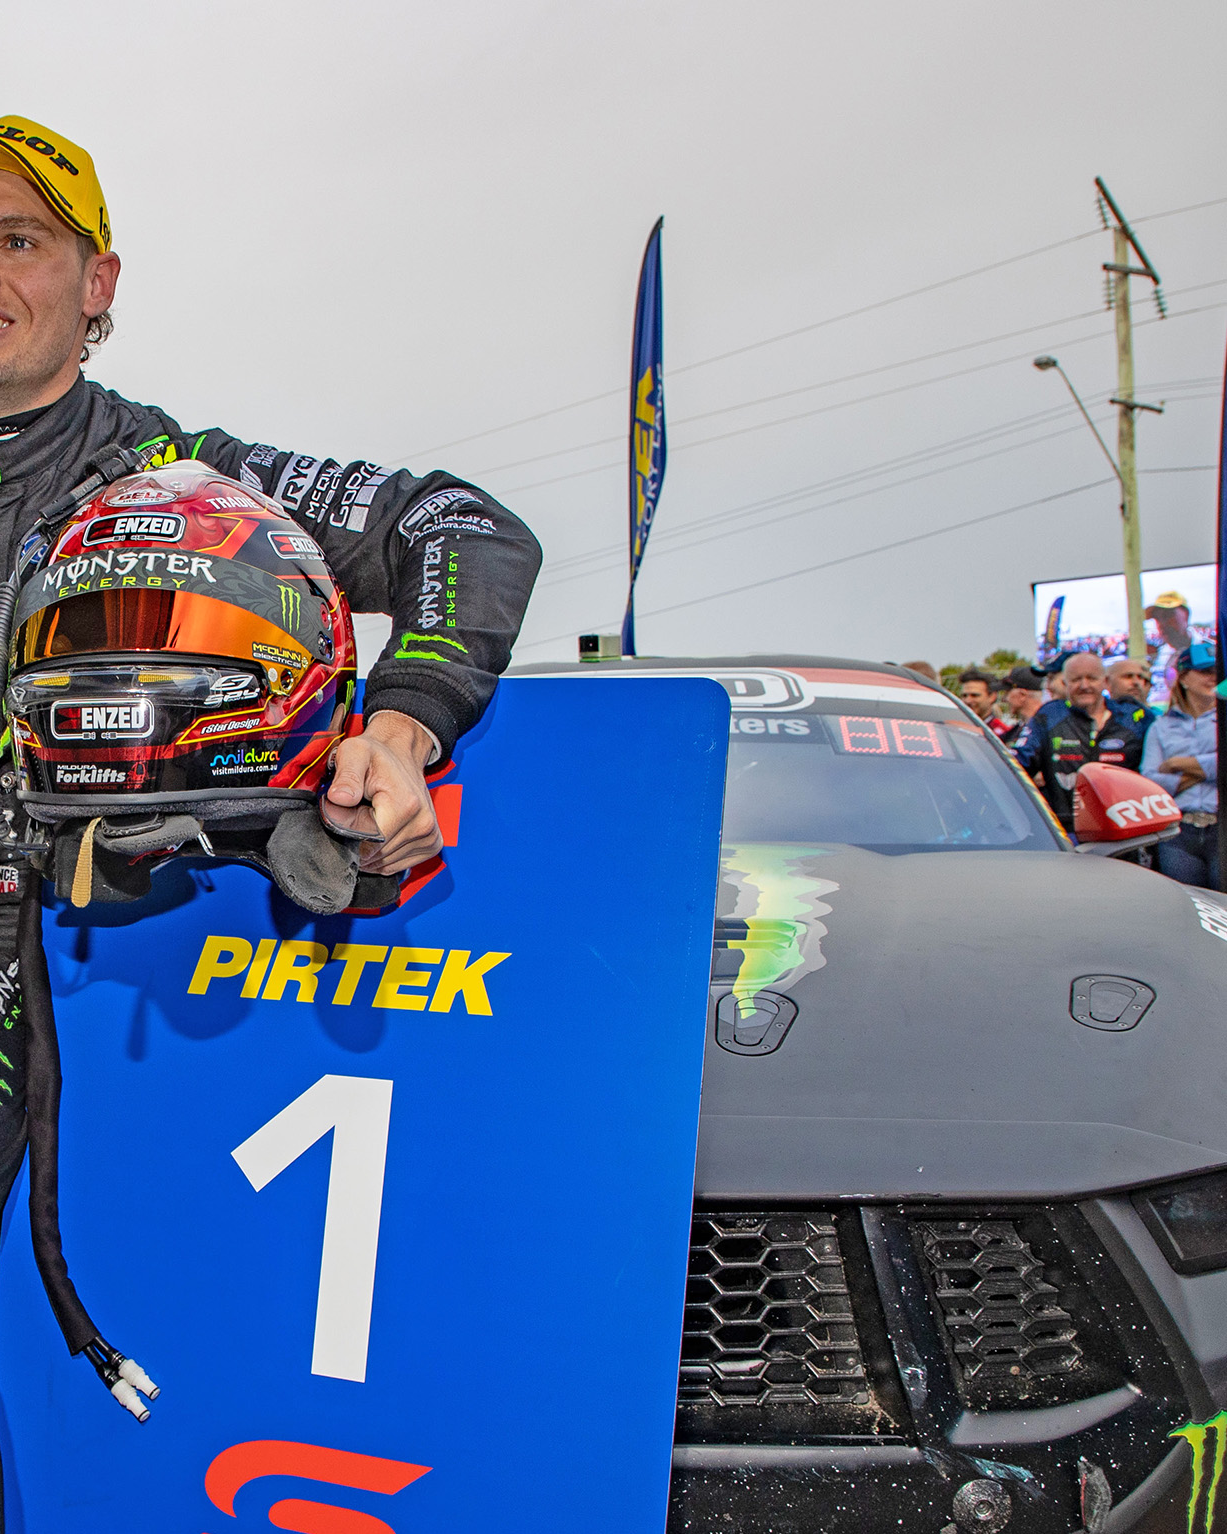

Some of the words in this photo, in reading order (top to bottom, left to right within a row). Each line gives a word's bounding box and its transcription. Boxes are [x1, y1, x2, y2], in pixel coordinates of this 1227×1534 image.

[205, 497, 261, 510] TRADIE
[113, 517, 176, 535] ENZED
[42, 550, 217, 593] MONSTER
[417, 535, 446, 629] ONSTER
[58, 576, 187, 598] ENERGY
[446, 550, 460, 627] ENERGY
[203, 688, 261, 706] SPY
[81, 707, 146, 730] ENZED
[729, 717, 810, 735] ters
[209, 747, 281, 767] mildura
[56, 768, 126, 783] Forklifts
[211, 764, 279, 776] visitmildura.com.au
[186, 935, 513, 1016] PIRTEK
[231, 1074, 393, 1383] 1
